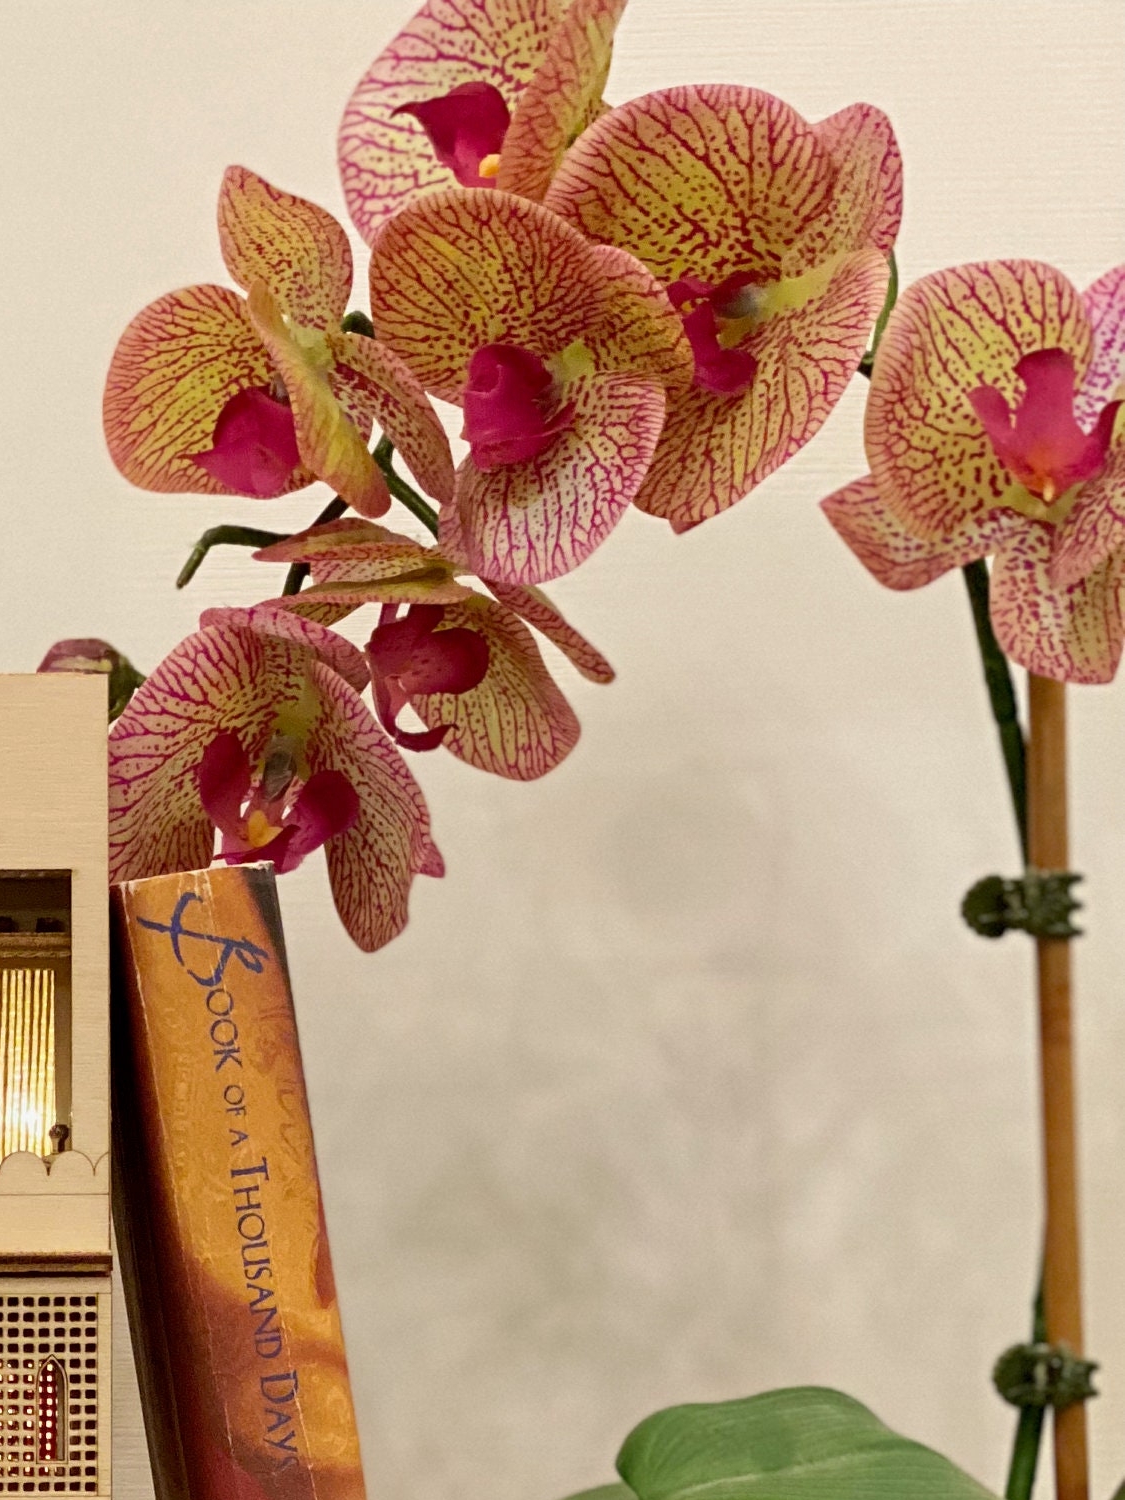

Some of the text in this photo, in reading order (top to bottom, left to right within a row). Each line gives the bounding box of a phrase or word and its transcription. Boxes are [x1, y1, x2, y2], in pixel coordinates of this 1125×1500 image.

[224, 1084, 247, 1117] OF
[229, 1129, 249, 1147] A
[230, 1156, 283, 1359] THOUSAND
